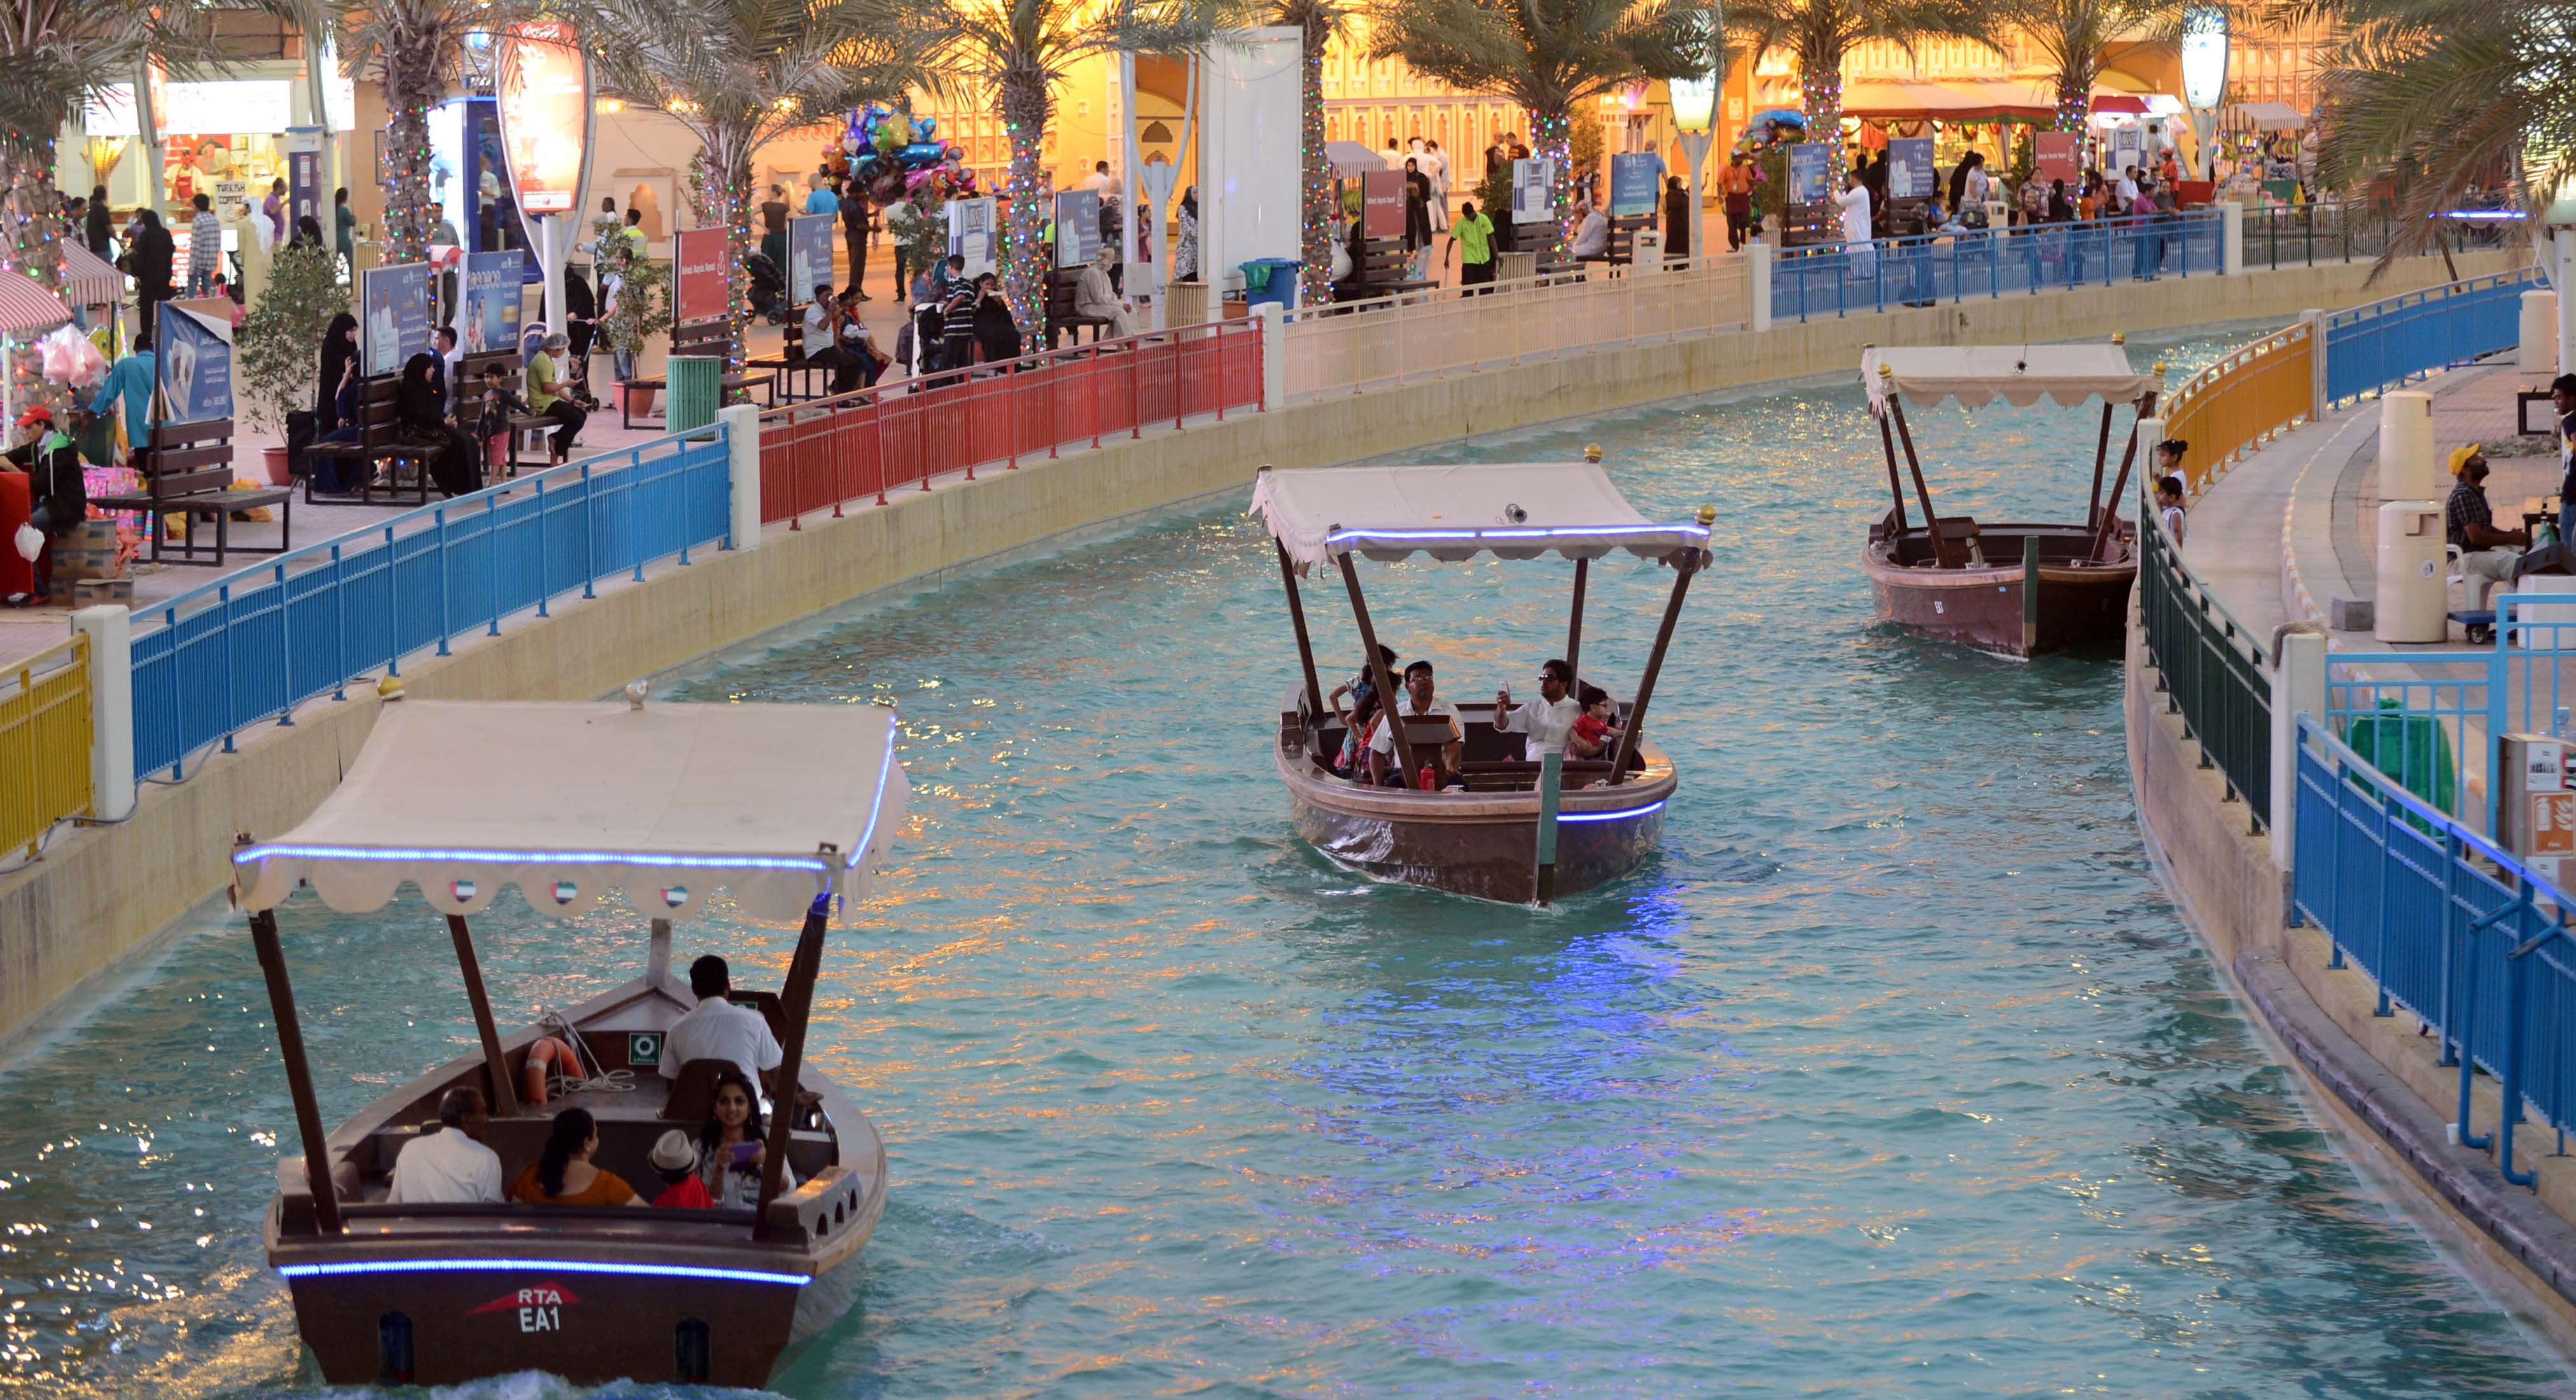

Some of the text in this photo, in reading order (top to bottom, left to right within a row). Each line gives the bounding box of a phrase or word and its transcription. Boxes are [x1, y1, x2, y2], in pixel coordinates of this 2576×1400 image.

[216, 183, 245, 192] TURKISH
[519, 1288, 563, 1305] RTA
[519, 1306, 560, 1333] EA1
